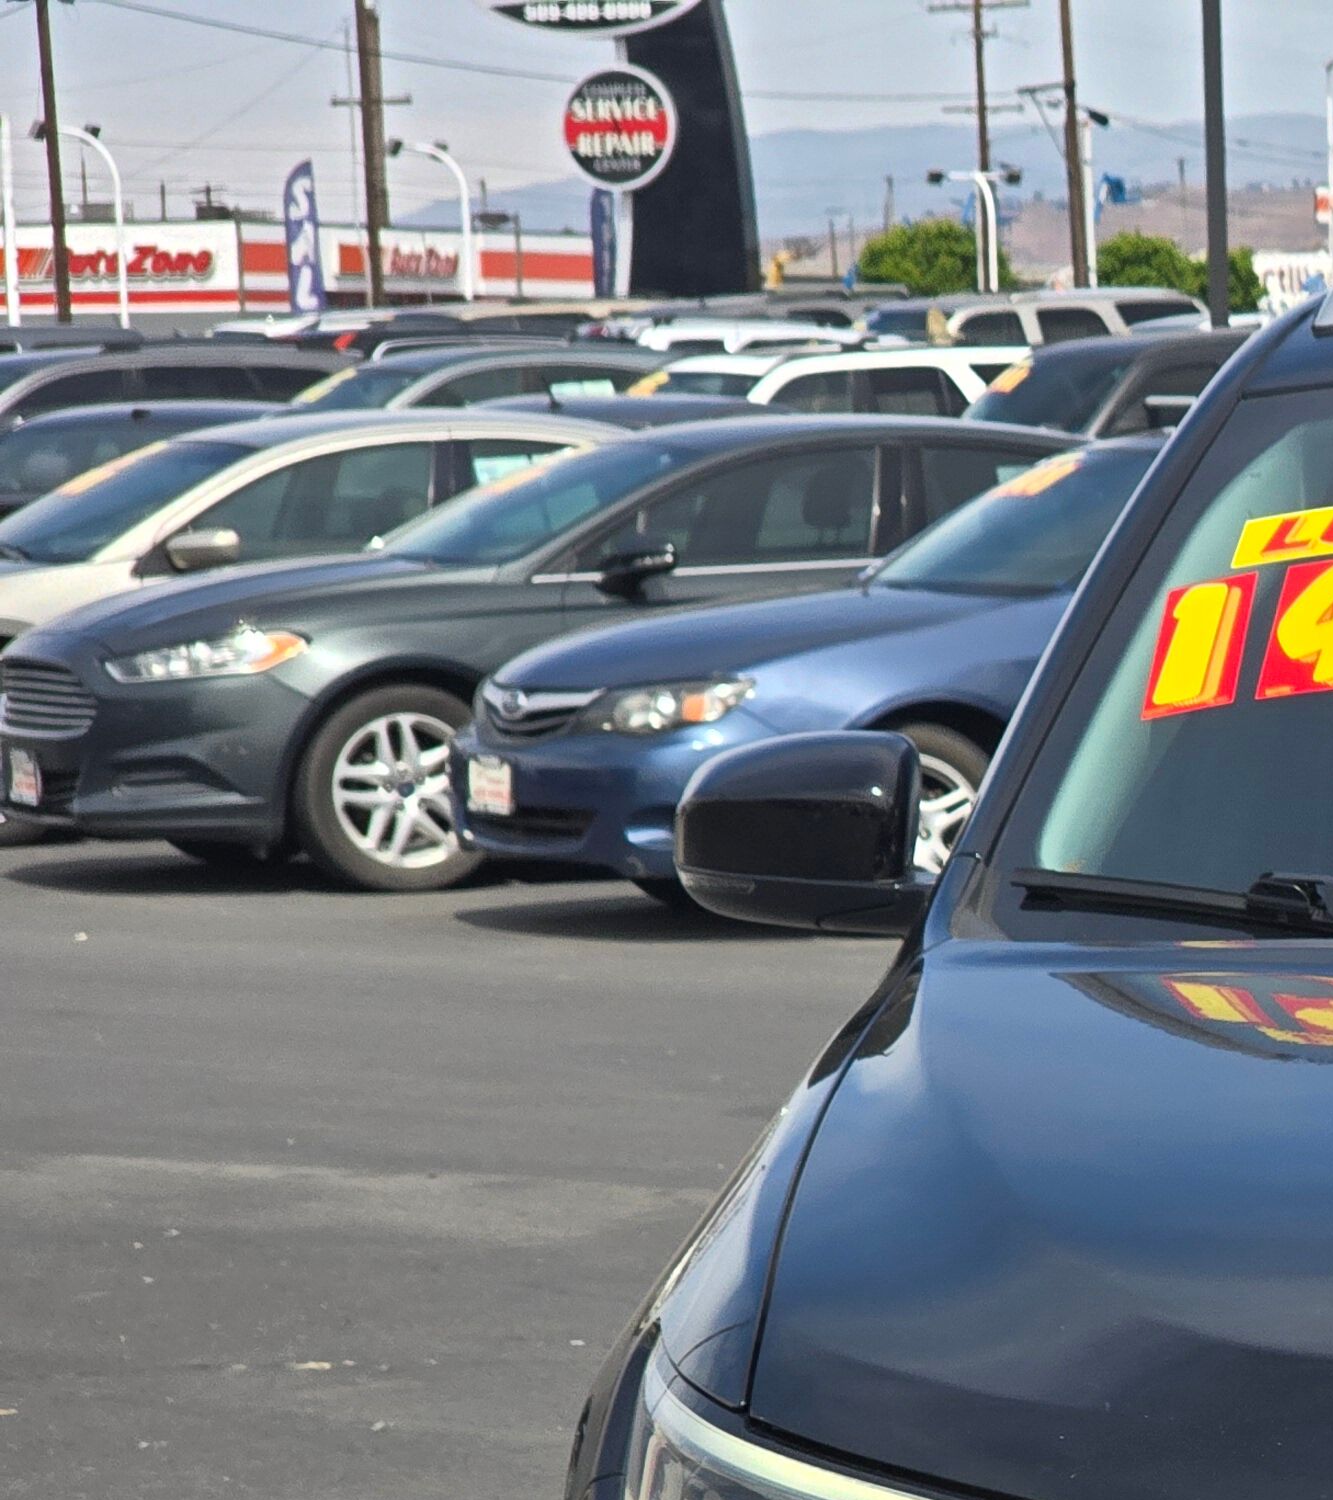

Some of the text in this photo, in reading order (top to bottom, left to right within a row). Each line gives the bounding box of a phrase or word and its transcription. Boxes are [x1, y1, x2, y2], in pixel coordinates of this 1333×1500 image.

[571, 97, 659, 121] SERVICE
[576, 132, 656, 157] REPAIR
[289, 176, 319, 311] SAL
